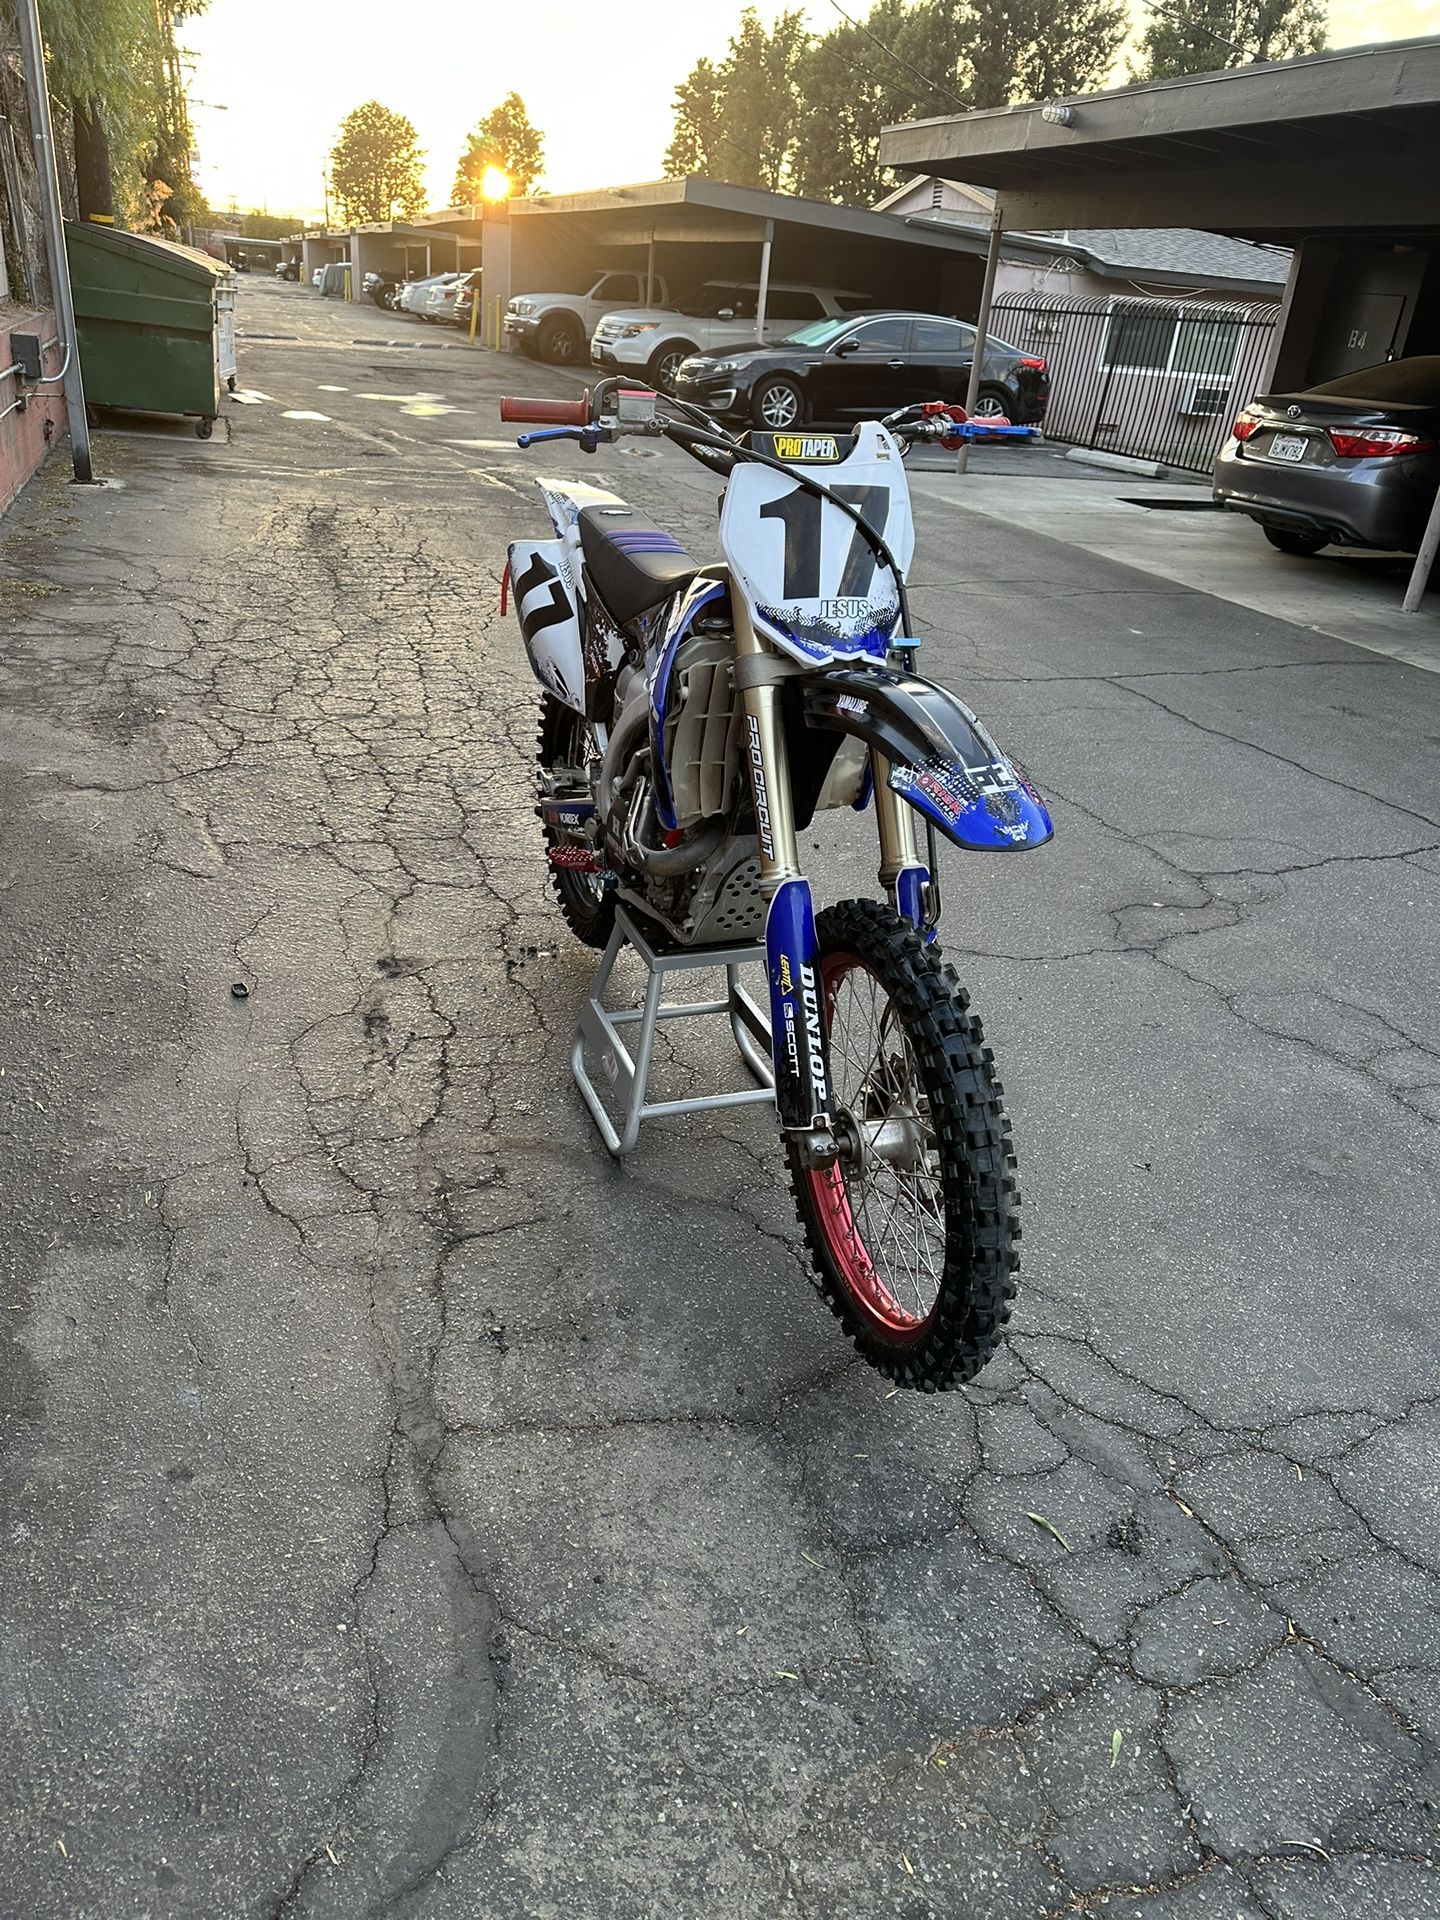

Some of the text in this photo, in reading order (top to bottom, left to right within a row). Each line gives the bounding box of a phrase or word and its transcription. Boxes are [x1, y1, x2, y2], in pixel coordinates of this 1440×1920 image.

[1347, 329, 1368, 350] B4
[778, 437, 836, 459] PROTAPER
[759, 483, 891, 600] 17
[559, 559, 576, 590] JESUS
[515, 552, 575, 643] 17
[819, 599, 869, 619] JESUS
[836, 693, 870, 714] YAMALUBE
[746, 714, 776, 862] PRO CIRCUIT
[925, 786, 956, 819] RACING
[929, 778, 964, 815] RISK
[559, 812, 579, 825] VORTEX
[799, 962, 827, 1102] DUNLOP
[785, 1020, 800, 1078] SCOTT
